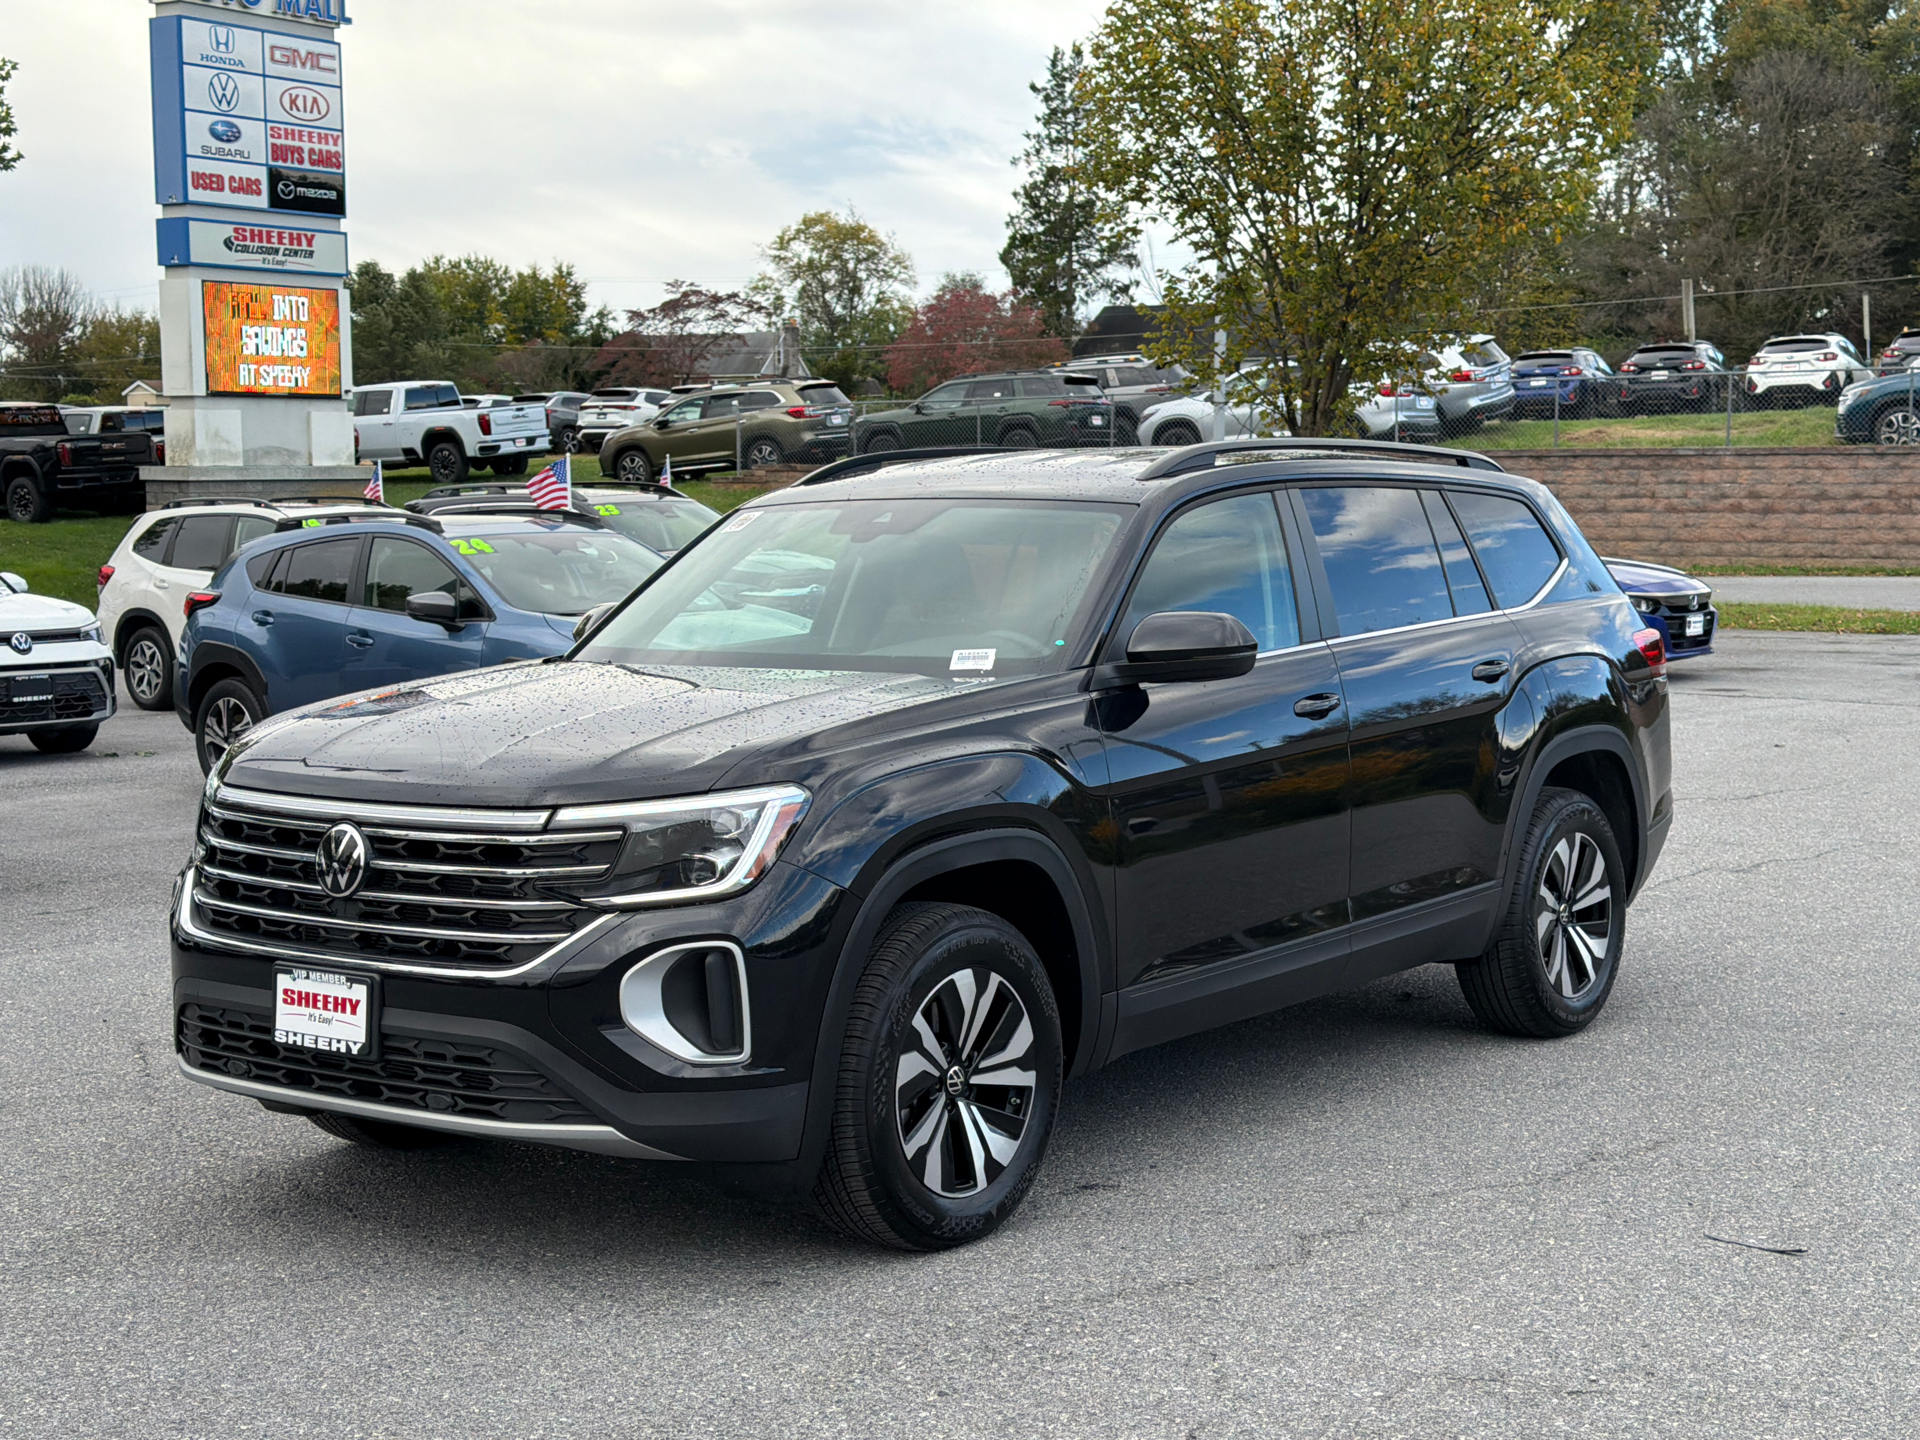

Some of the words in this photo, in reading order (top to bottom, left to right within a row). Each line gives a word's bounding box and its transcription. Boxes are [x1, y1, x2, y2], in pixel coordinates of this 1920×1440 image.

[200, 53, 245, 68] HONDA
[269, 45, 337, 74] GMC
[269, 126, 340, 147] SHEEHY
[200, 145, 250, 160] SUBARU
[270, 143, 304, 165] BUYS
[308, 147, 342, 170] CARS
[191, 171, 225, 193] USED
[228, 175, 265, 196] CARS
[296, 187, 338, 200] mazda
[233, 226, 316, 248] SHEEHY
[233, 243, 281, 256] COLLISION
[282, 247, 315, 259] CENTER
[272, 294, 308, 321] INTO
[239, 364, 258, 386] AT
[259, 365, 311, 387] SHEEHY
[593, 504, 620, 516] 23
[13, 694, 53, 702] SHEEHY
[292, 969, 307, 980] VIP
[309, 971, 347, 986] MEMBER
[282, 988, 361, 1016] SHEEHY
[307, 1012, 317, 1022] It's
[318, 1013, 334, 1026] Easy!
[274, 1030, 363, 1055] SHEEHY
